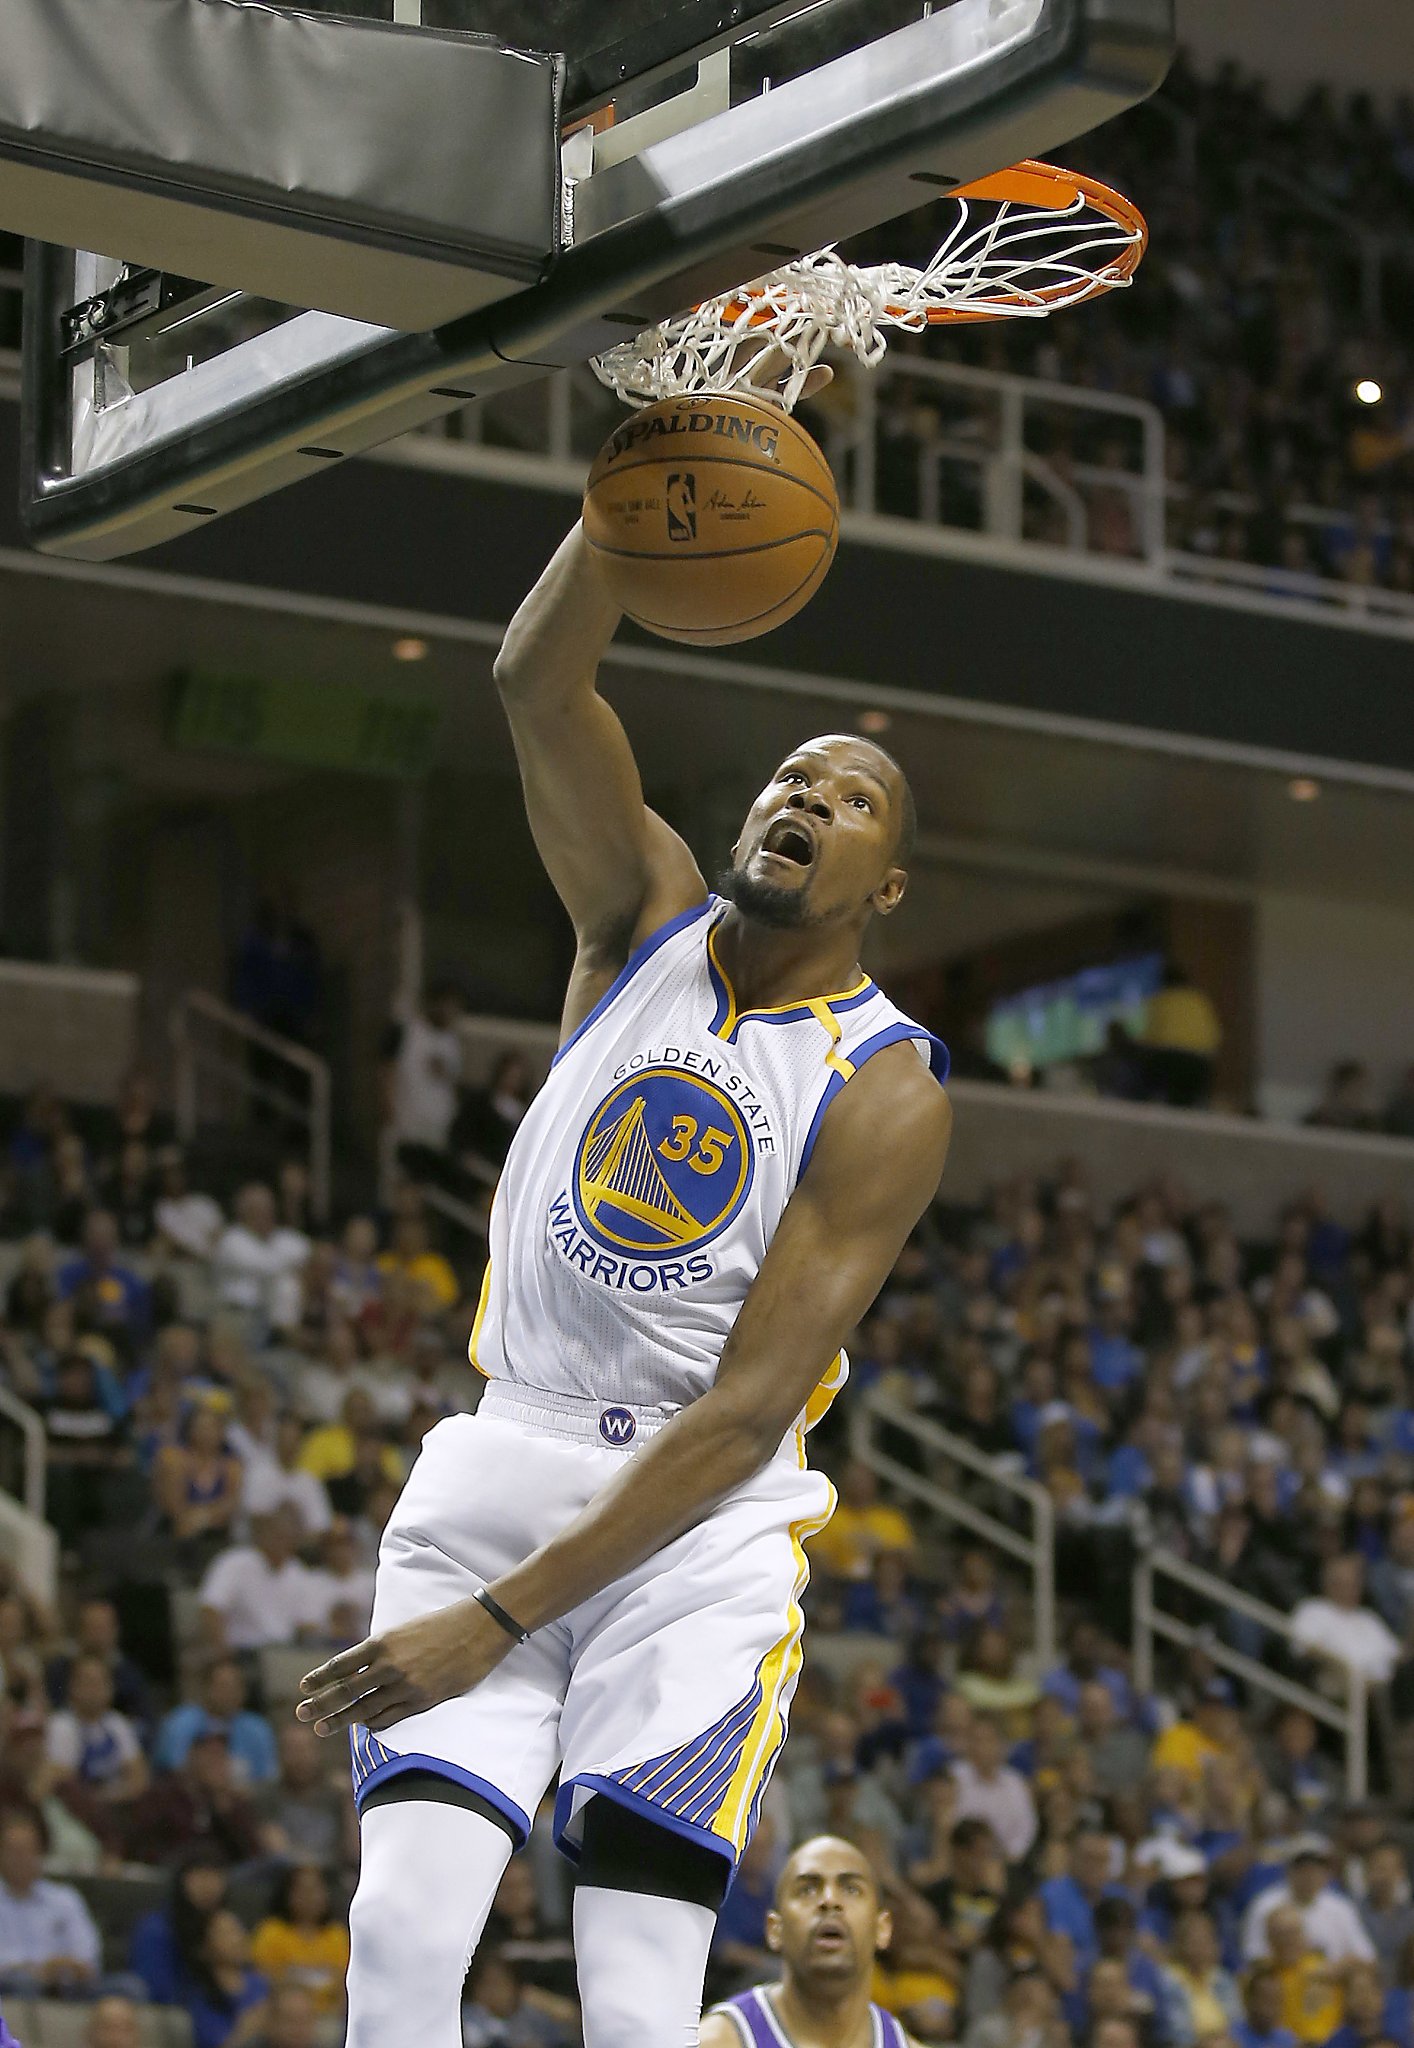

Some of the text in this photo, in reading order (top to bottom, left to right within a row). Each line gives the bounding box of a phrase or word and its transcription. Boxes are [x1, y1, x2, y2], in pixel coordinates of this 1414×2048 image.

[608, 413, 780, 464] SPALDING
[614, 1047, 775, 1156] GOLDEN STATE
[657, 1115, 735, 1175] 35
[549, 1189, 713, 1292] WARRIORS
[604, 1416, 632, 1437] W
